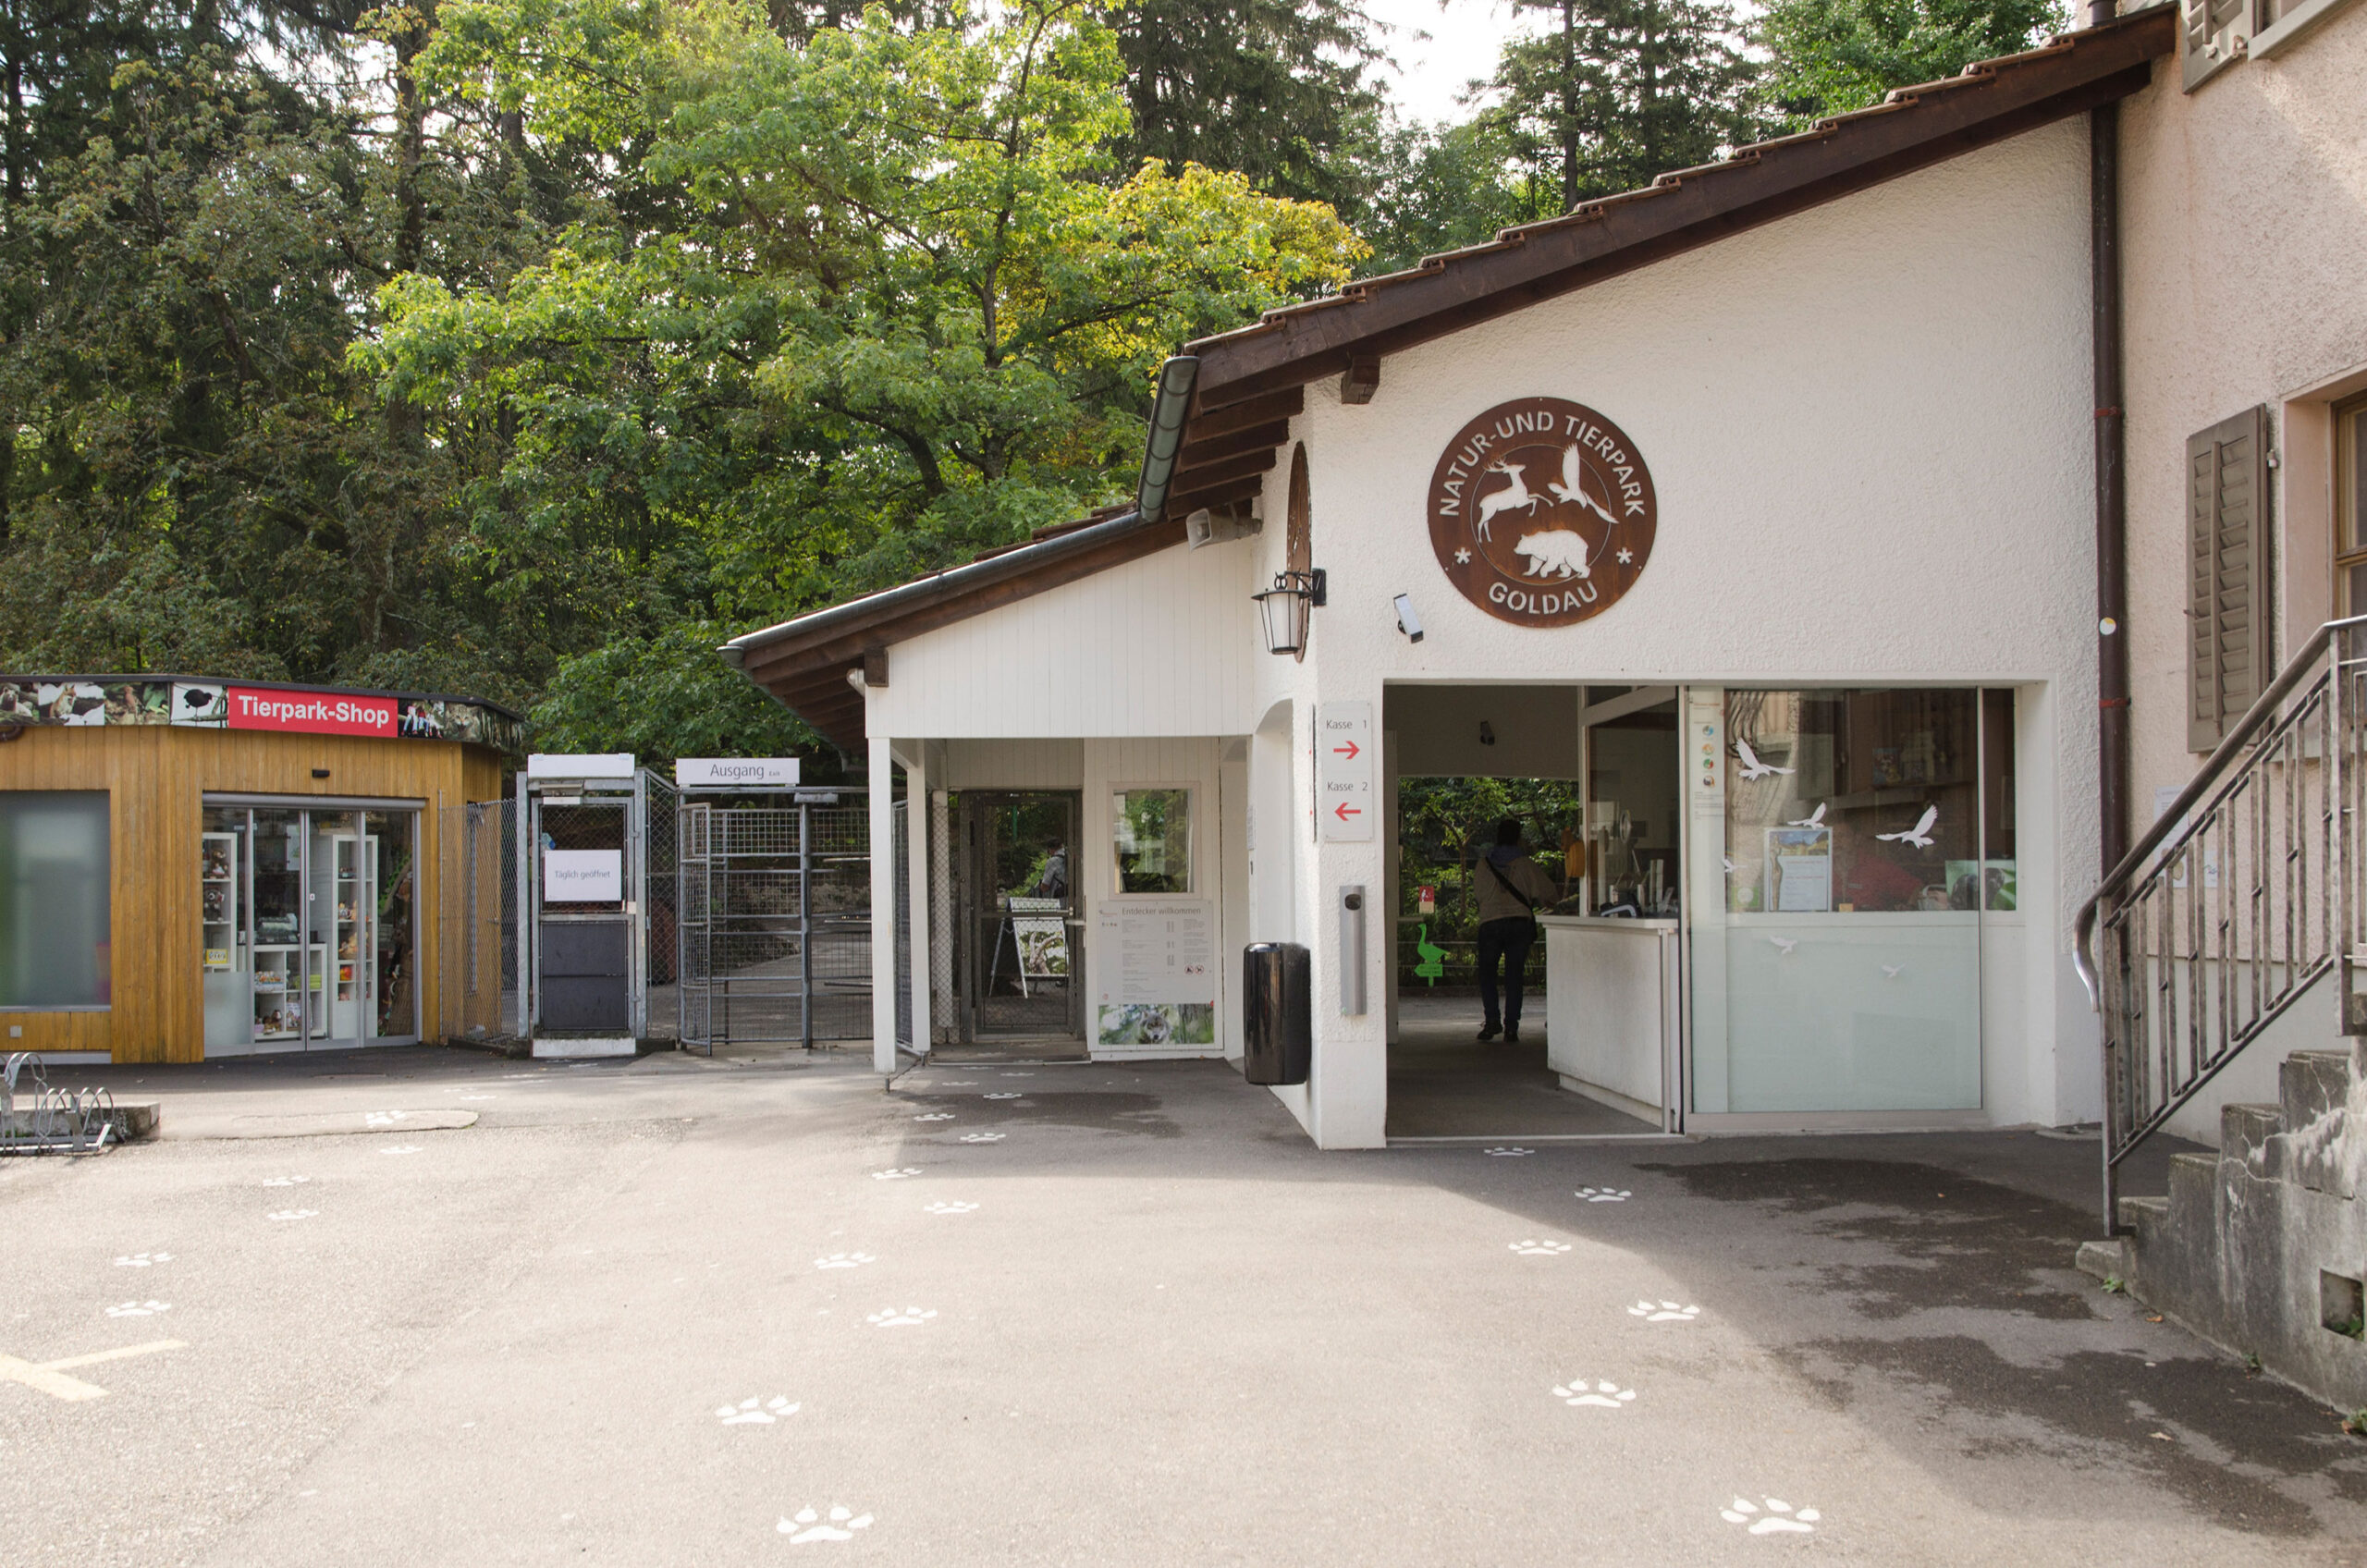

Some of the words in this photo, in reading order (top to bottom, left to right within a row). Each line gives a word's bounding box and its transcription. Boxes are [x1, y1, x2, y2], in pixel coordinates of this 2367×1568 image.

[1565, 414, 1646, 518] TIERPARK
[1488, 580, 1599, 615] GOLDAU
[238, 694, 389, 729] Tierpark-Shop
[1326, 719, 1353, 729] Kasse
[1362, 719, 1367, 729] 1
[710, 764, 765, 779] Ausgang
[1327, 781, 1354, 791] Kasse
[1362, 781, 1367, 791] 2
[555, 870, 579, 880] Täglich
[580, 870, 610, 880] geöffnet
[1122, 907, 1156, 915] Entdecker
[1158, 906, 1201, 915] willkommen
